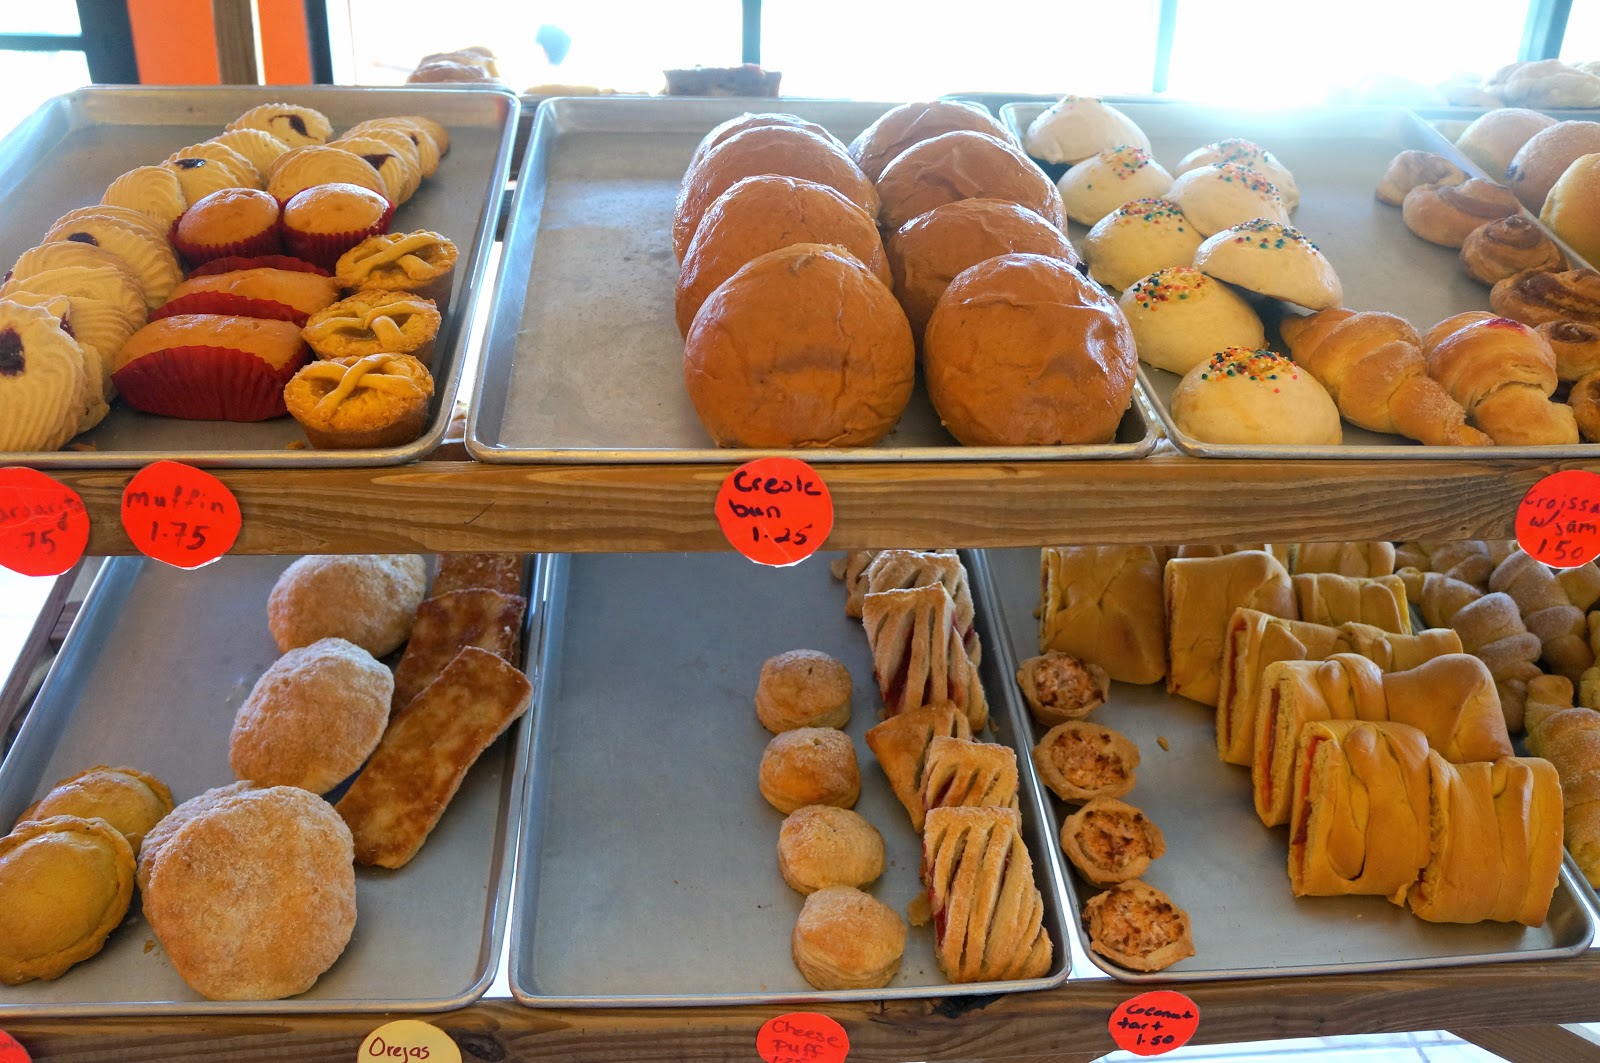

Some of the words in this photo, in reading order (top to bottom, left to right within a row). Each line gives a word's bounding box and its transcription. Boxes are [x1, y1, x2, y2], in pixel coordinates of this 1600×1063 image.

[728, 498, 781, 519] bun
[151, 520, 210, 550] 1.75
[752, 523, 813, 545] 1.25
[1537, 538, 1584, 560] 1.50
[1116, 1016, 1164, 1031] tart
[368, 1036, 431, 1063] Orejas
[1136, 1033, 1175, 1046] 1.50
